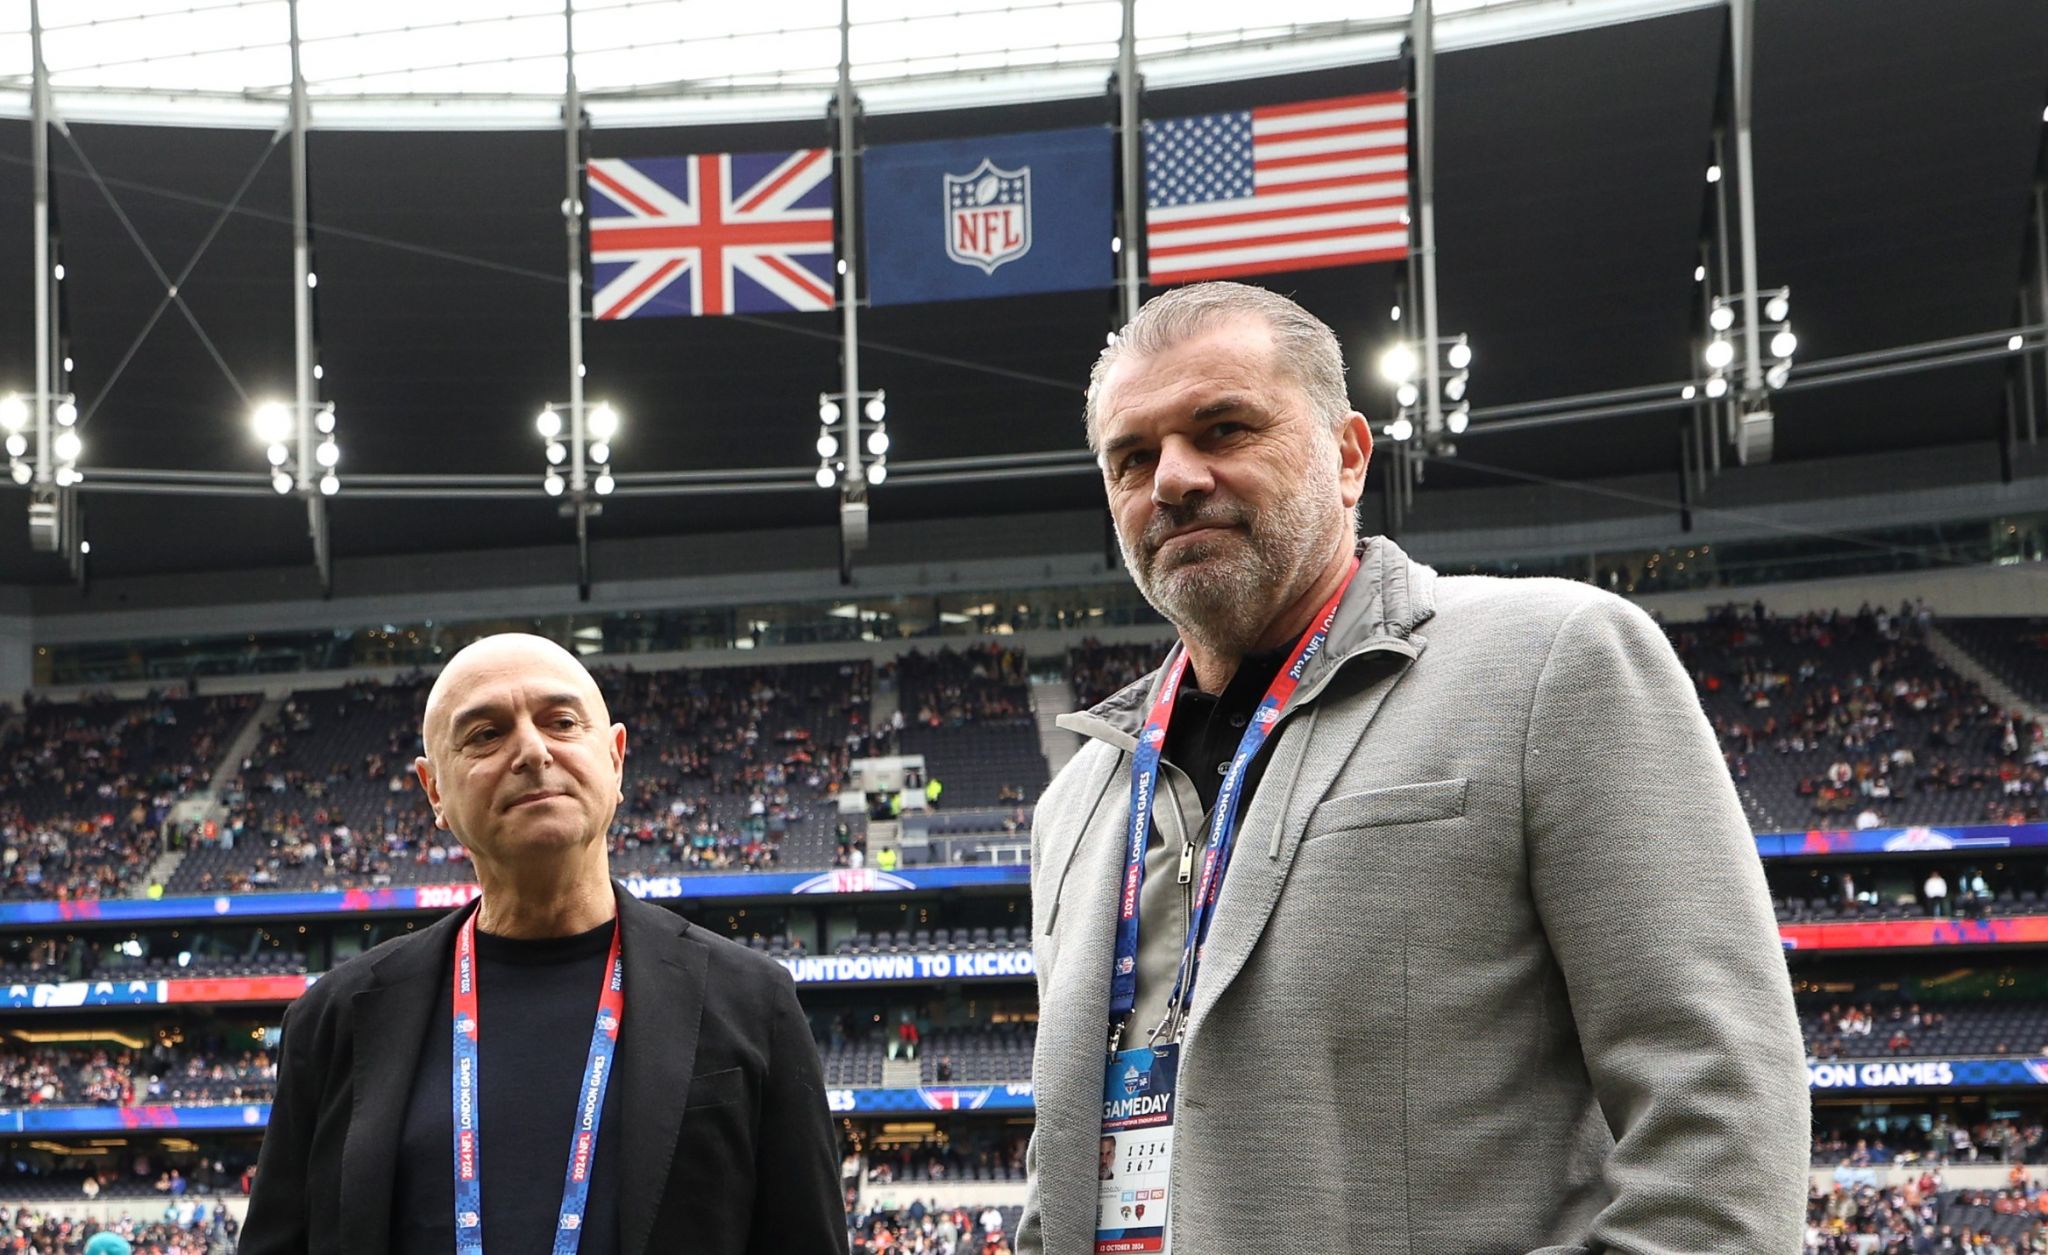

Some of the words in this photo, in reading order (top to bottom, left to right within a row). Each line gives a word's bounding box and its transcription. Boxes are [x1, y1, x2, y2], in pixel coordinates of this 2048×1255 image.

[957, 210, 1021, 255] NFL
[1305, 635, 1326, 656] NFL
[1137, 771, 1151, 811] GAMES
[1211, 793, 1231, 847] LONDON
[1225, 752, 1247, 791] GAMES
[1132, 811, 1146, 863] LONDON
[1129, 866, 1138, 887] NFL
[419, 887, 467, 908] 2024
[1123, 888, 1134, 918] 2024
[918, 955, 950, 978] TO
[460, 1057, 470, 1086] GAMES
[590, 1056, 605, 1087] GAMES
[1860, 1062, 1953, 1086] GAMES
[460, 1086, 471, 1129] LONDON
[582, 1087, 598, 1131] LONDON
[1103, 1093, 1170, 1119] GAMEDAY
[462, 1133, 472, 1152] NFL
[578, 1134, 591, 1155] NFL
[462, 1154, 473, 1178] 2024
[574, 1157, 586, 1180] 2024
